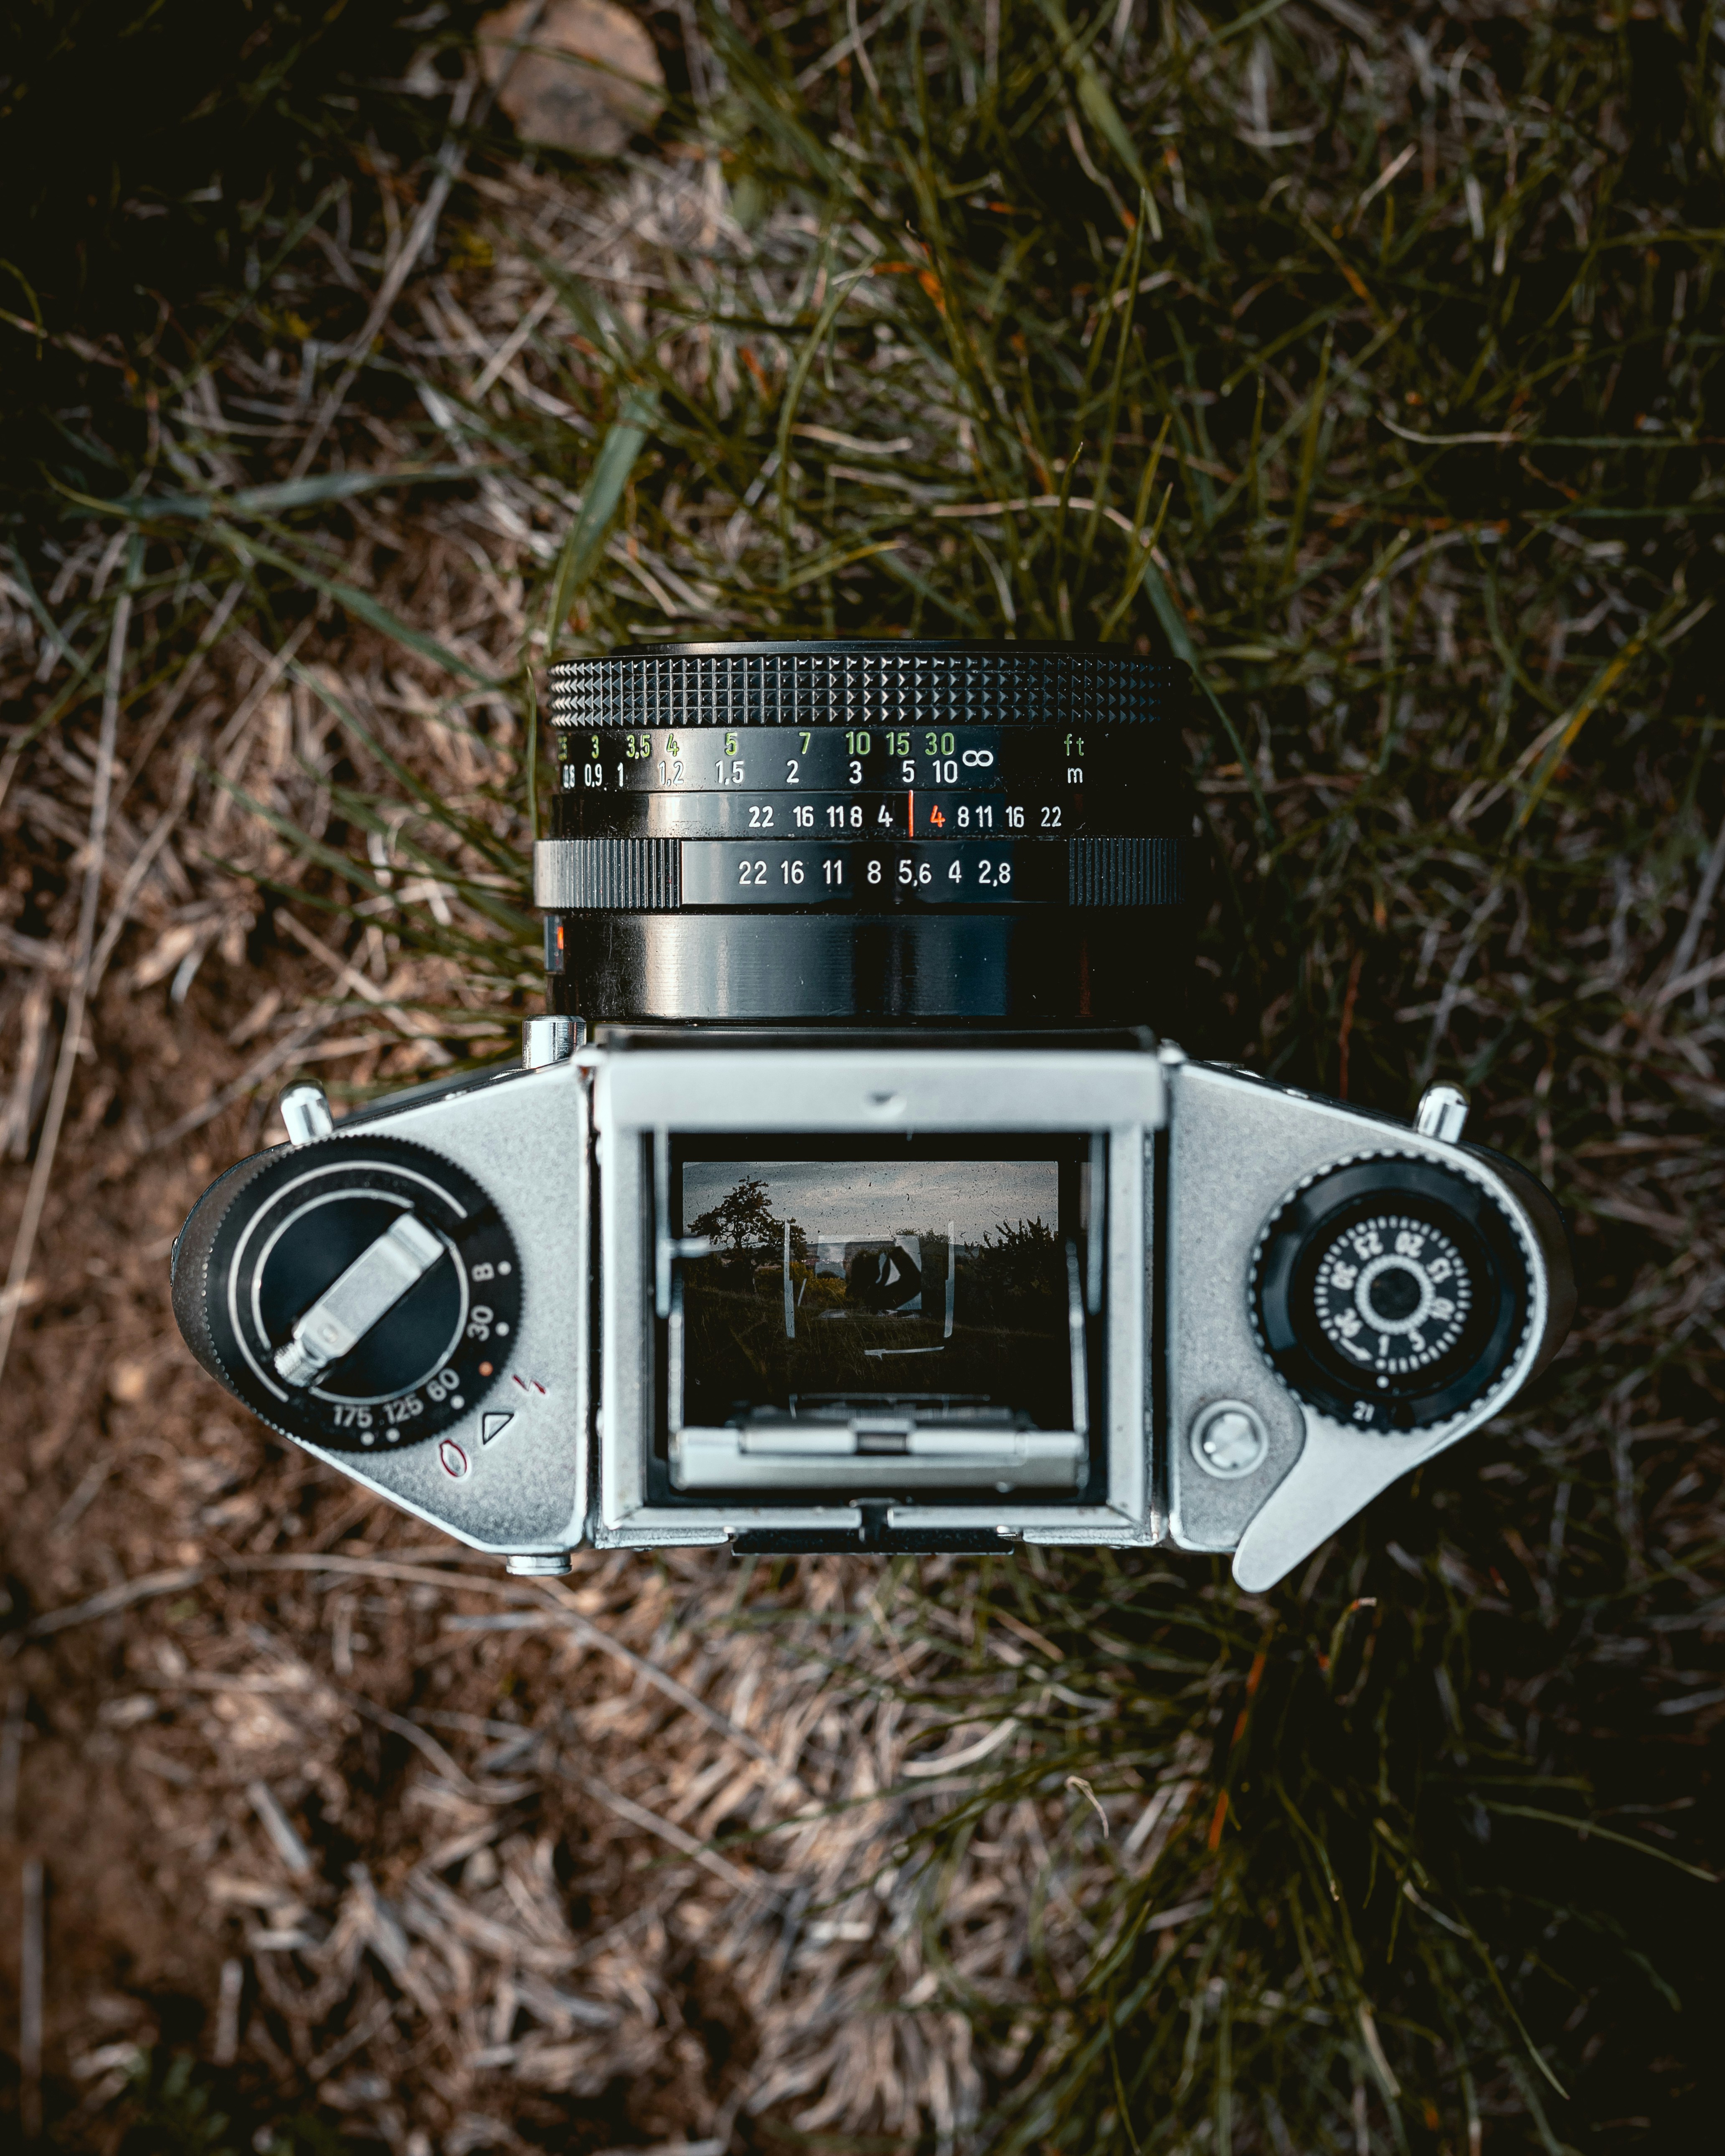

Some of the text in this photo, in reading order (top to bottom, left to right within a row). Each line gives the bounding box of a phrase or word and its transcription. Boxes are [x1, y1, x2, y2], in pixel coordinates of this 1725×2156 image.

[591, 735, 599, 759] 3
[626, 734, 650, 759] 3,5
[666, 734, 679, 756] 4
[726, 732, 738, 755] 5
[799, 732, 811, 755] 7
[845, 731, 870, 755] 10
[886, 732, 911, 755] 15
[925, 732, 955, 755] 30
[1064, 733, 1085, 756] ft
[584, 763, 602, 787] 0,9
[617, 762, 624, 787] 1
[658, 762, 684, 785] 1,2
[715, 760, 745, 786] 1,5
[786, 760, 799, 783] 2
[849, 761, 862, 784] 3
[902, 760, 915, 783] 5
[932, 760, 958, 783] 10
[1068, 767, 1083, 784] m
[748, 805, 1062, 828] 22 16 11 8 4 4 8 11 16 22
[738, 859, 1011, 887] 22 16 11 8 5,6 4 2,8
[1352, 1230, 1384, 1260] 25
[1394, 1230, 1426, 1258] 20
[1331, 1260, 1358, 1291] 30
[1428, 1296, 1456, 1321] 10
[1334, 1307, 1363, 1339] 36
[334, 1262, 495, 1428] 175 125 60 30 B
[1378, 1333, 1390, 1357] 1
[1408, 1330, 1426, 1352] 5
[1352, 1400, 1375, 1423] 21
